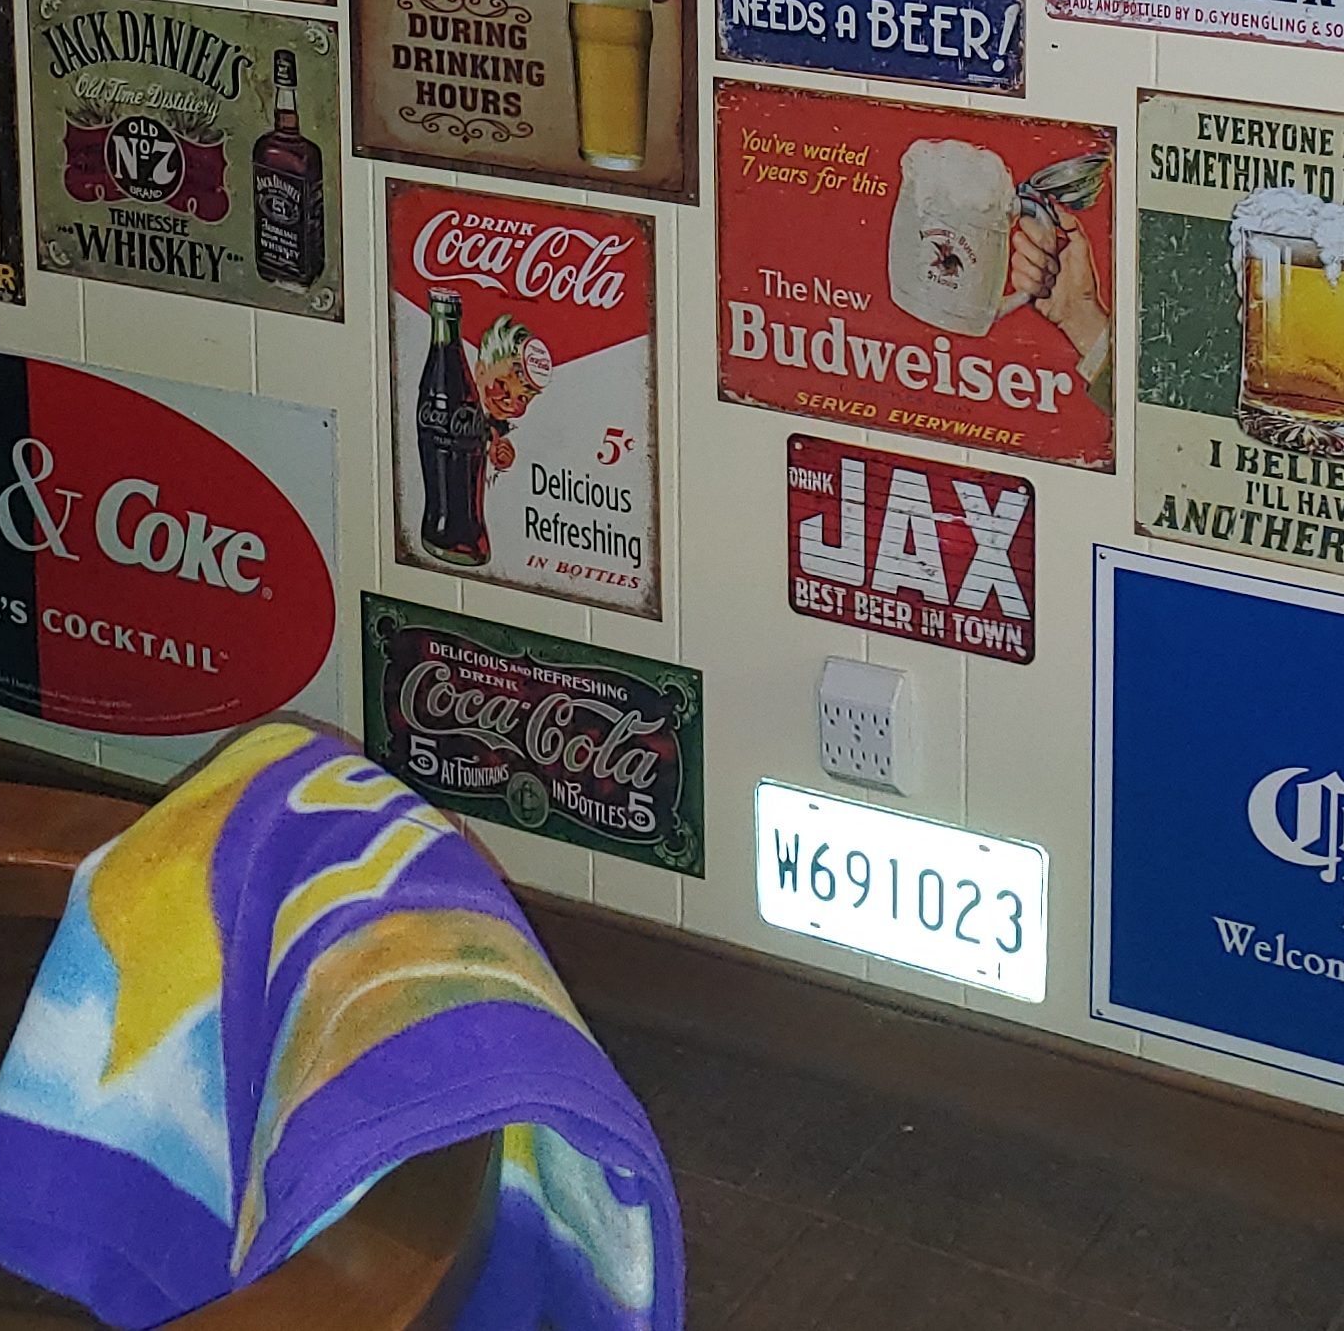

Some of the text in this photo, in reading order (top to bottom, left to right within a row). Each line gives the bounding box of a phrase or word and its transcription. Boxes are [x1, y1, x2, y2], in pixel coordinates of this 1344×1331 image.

[42, 10, 254, 101] JACK DANIEL'S
[408, 13, 527, 51] DURING
[392, 45, 545, 87] DRINKING
[416, 81, 522, 117] HOURS
[802, 143, 869, 168] waited
[1197, 112, 1334, 158] EVERYONE
[1150, 143, 1296, 196] SOMETHING
[109, 207, 190, 236] TENNESSEE
[73, 222, 227, 283] WHISKEY
[413, 210, 634, 310] Coca-Cola
[758, 268, 808, 303] The
[727, 300, 1073, 414] Budweiser
[887, 409, 1026, 447] EVERYWHERE
[531, 462, 632, 513] Delicious
[525, 507, 642, 569] Refreshing
[799, 457, 1032, 621] JAX
[555, 561, 642, 590] BOTTLES
[794, 576, 913, 632] BEST BEER
[42, 608, 221, 674] COCKTAIL
[429, 641, 628, 702] DELICIOUS REFRESHING
[400, 660, 666, 789] Coca-Cola
[774, 828, 1023, 954] W691023
